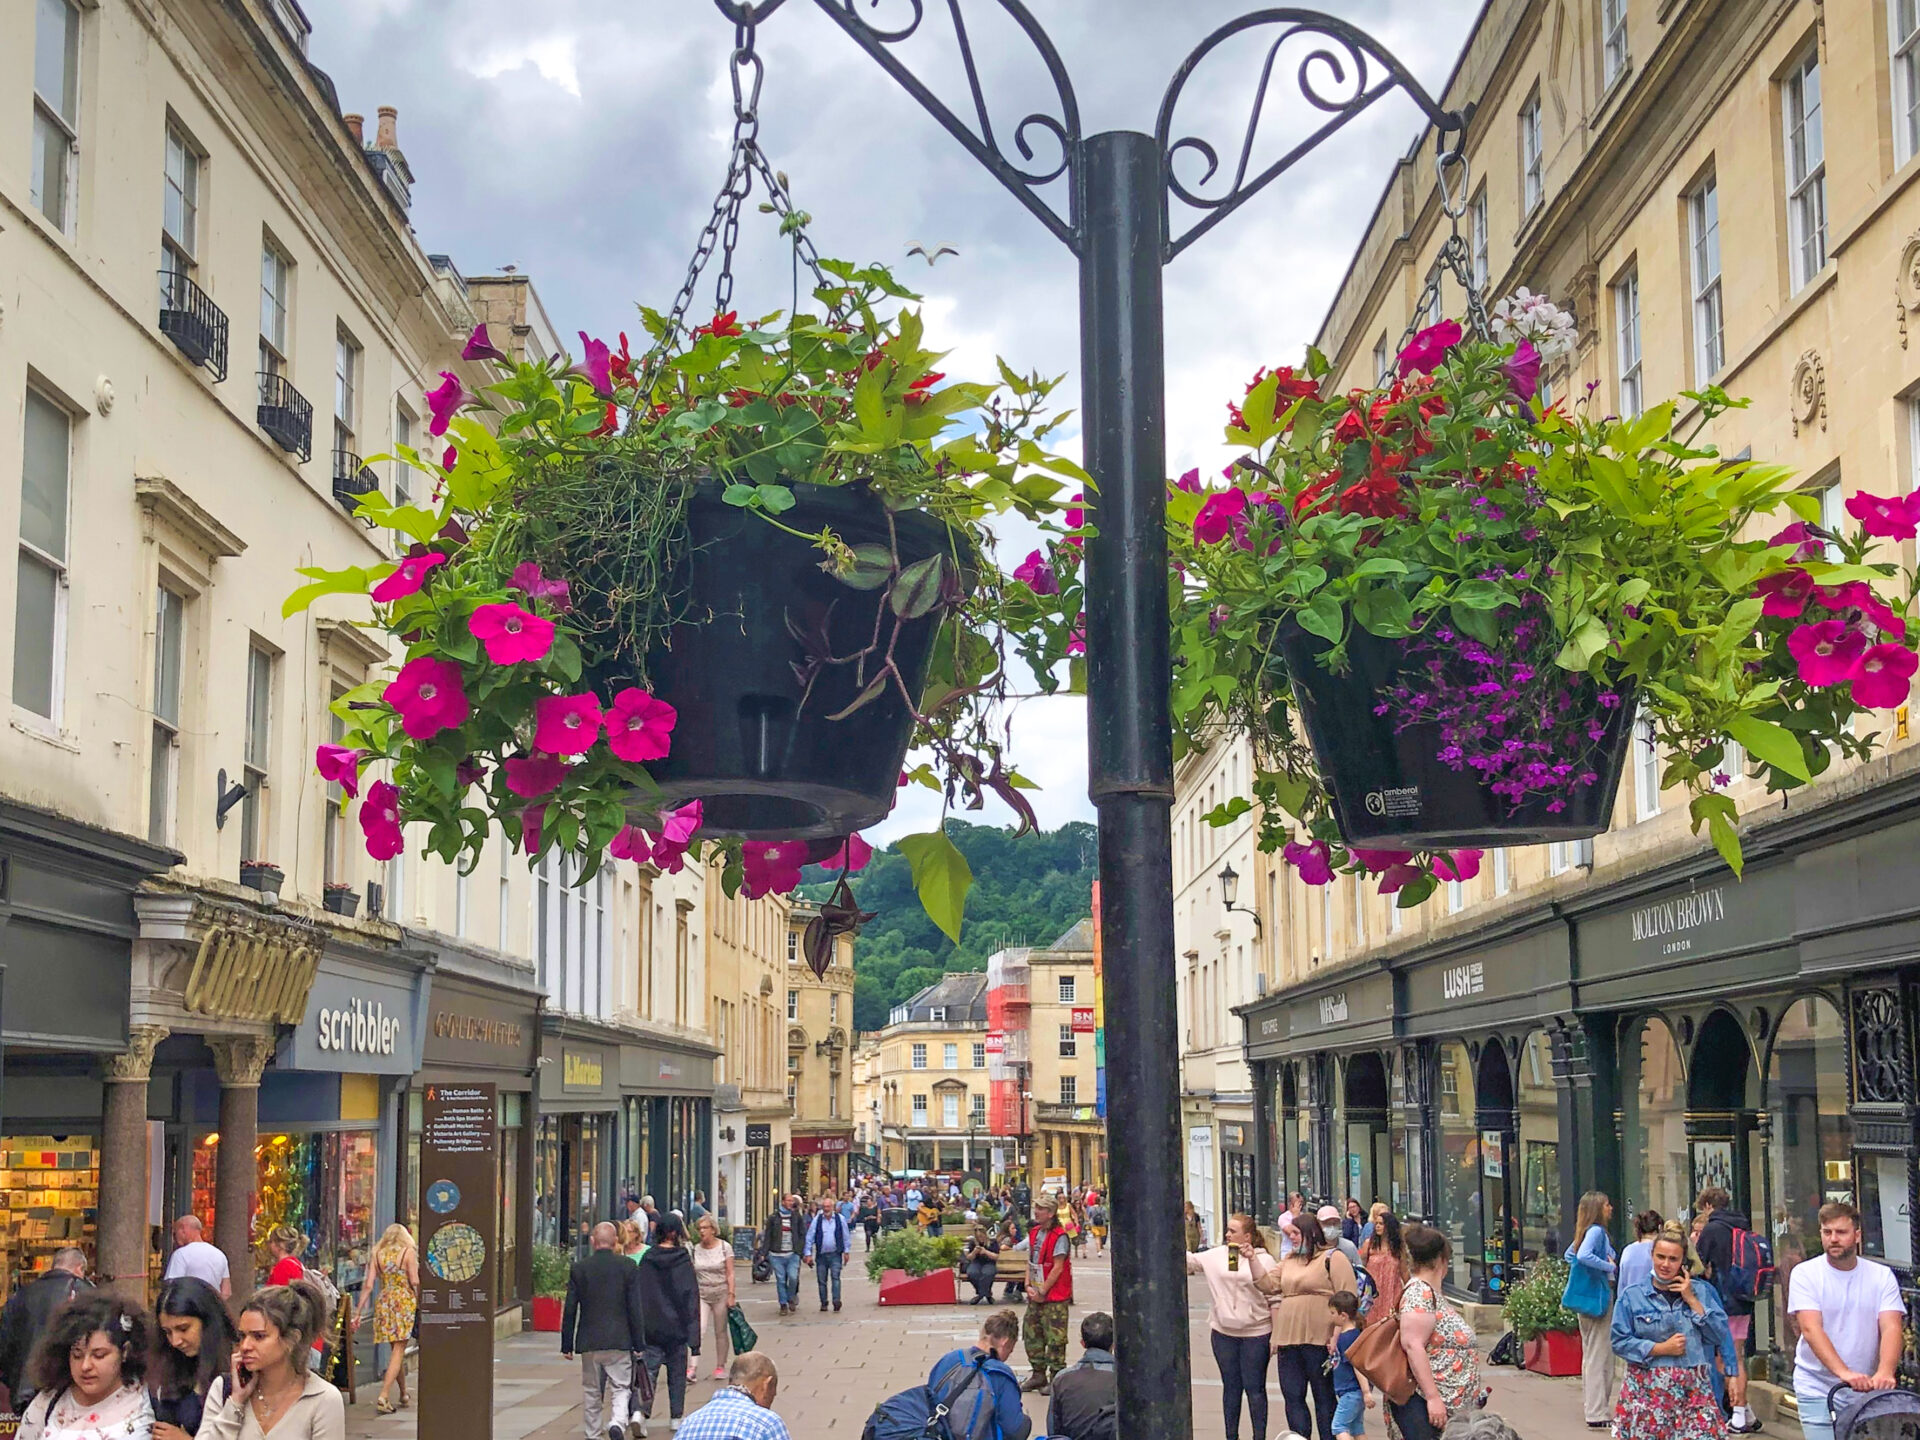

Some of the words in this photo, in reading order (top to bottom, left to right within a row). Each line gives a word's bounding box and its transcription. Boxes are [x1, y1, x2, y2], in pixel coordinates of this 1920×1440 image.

[1384, 786, 1418, 796] amberol
[1631, 901, 1675, 941] MOLTON
[1677, 888, 1724, 930] BROWN
[1662, 940, 1691, 954] LONDON
[1443, 965, 1470, 999] LUSH
[1073, 1011, 1093, 1020] SN
[319, 997, 400, 1055] scribbler
[986, 1036, 1003, 1045] SN
[749, 1130, 770, 1140] COS
